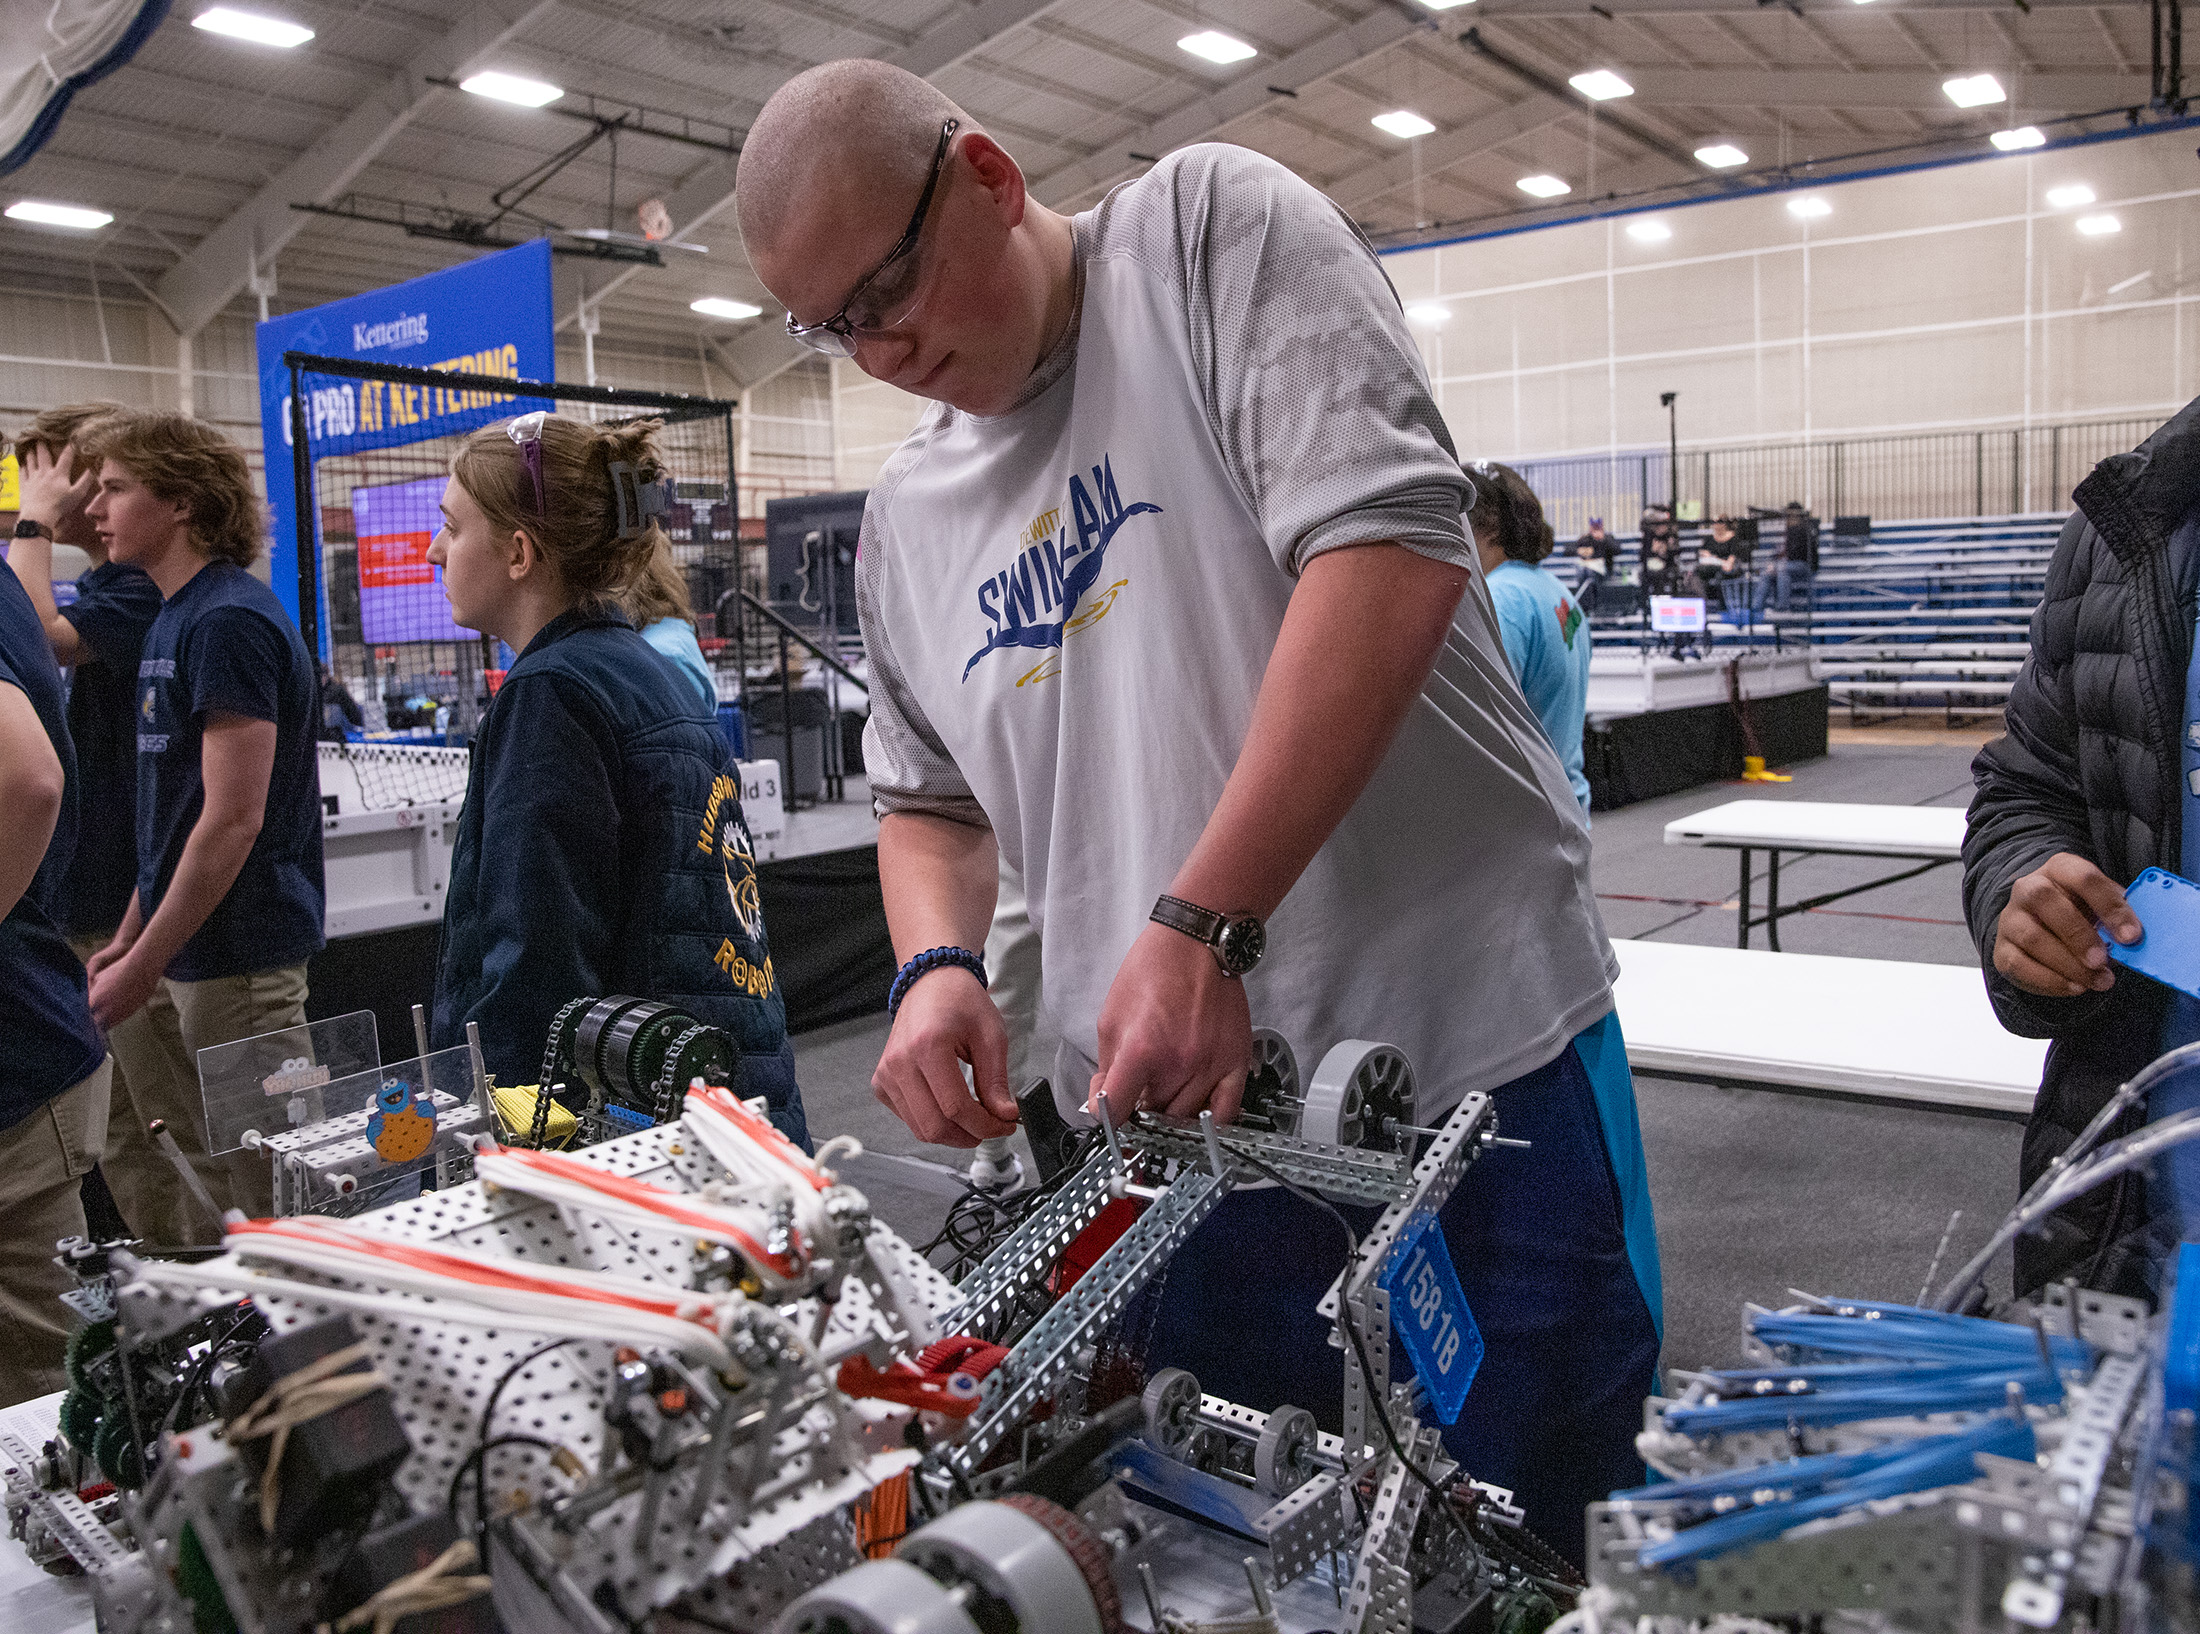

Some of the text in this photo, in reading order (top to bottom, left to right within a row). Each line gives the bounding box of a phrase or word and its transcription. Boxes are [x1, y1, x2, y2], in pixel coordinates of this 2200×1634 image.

[353, 312, 429, 351] Kettering
[312, 383, 355, 441] PRO
[359, 379, 386, 433] AT
[389, 343, 518, 428] KETTERING
[766, 779, 776, 798] 3
[1402, 1246, 1460, 1375] 1581B
